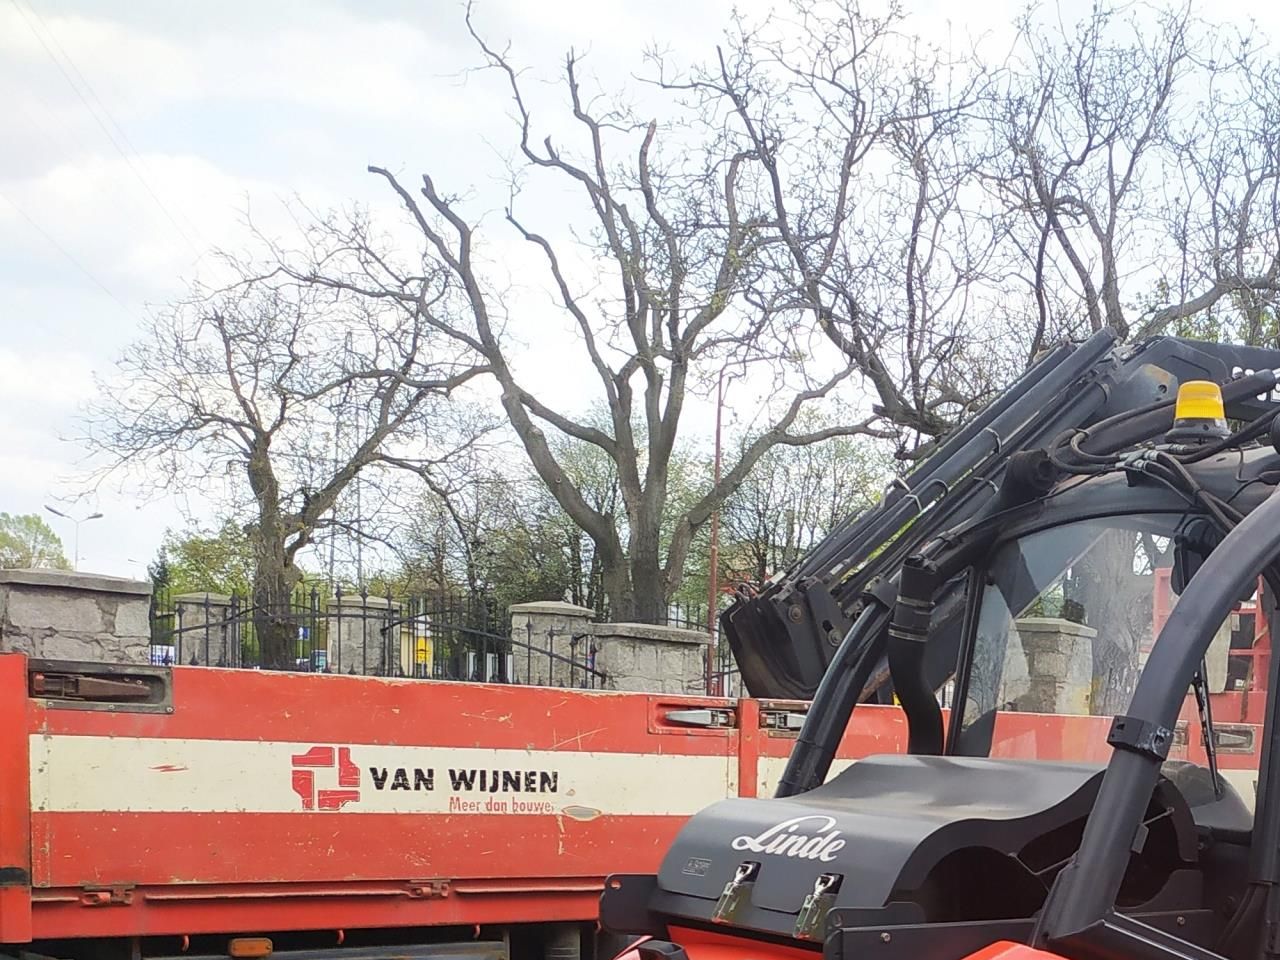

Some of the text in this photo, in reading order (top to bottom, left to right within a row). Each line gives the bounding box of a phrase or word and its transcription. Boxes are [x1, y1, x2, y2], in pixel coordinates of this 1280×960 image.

[369, 767, 558, 793] VAN WIJNEN
[449, 796, 554, 813] Meer dan bouwe
[731, 815, 846, 862] Linde
